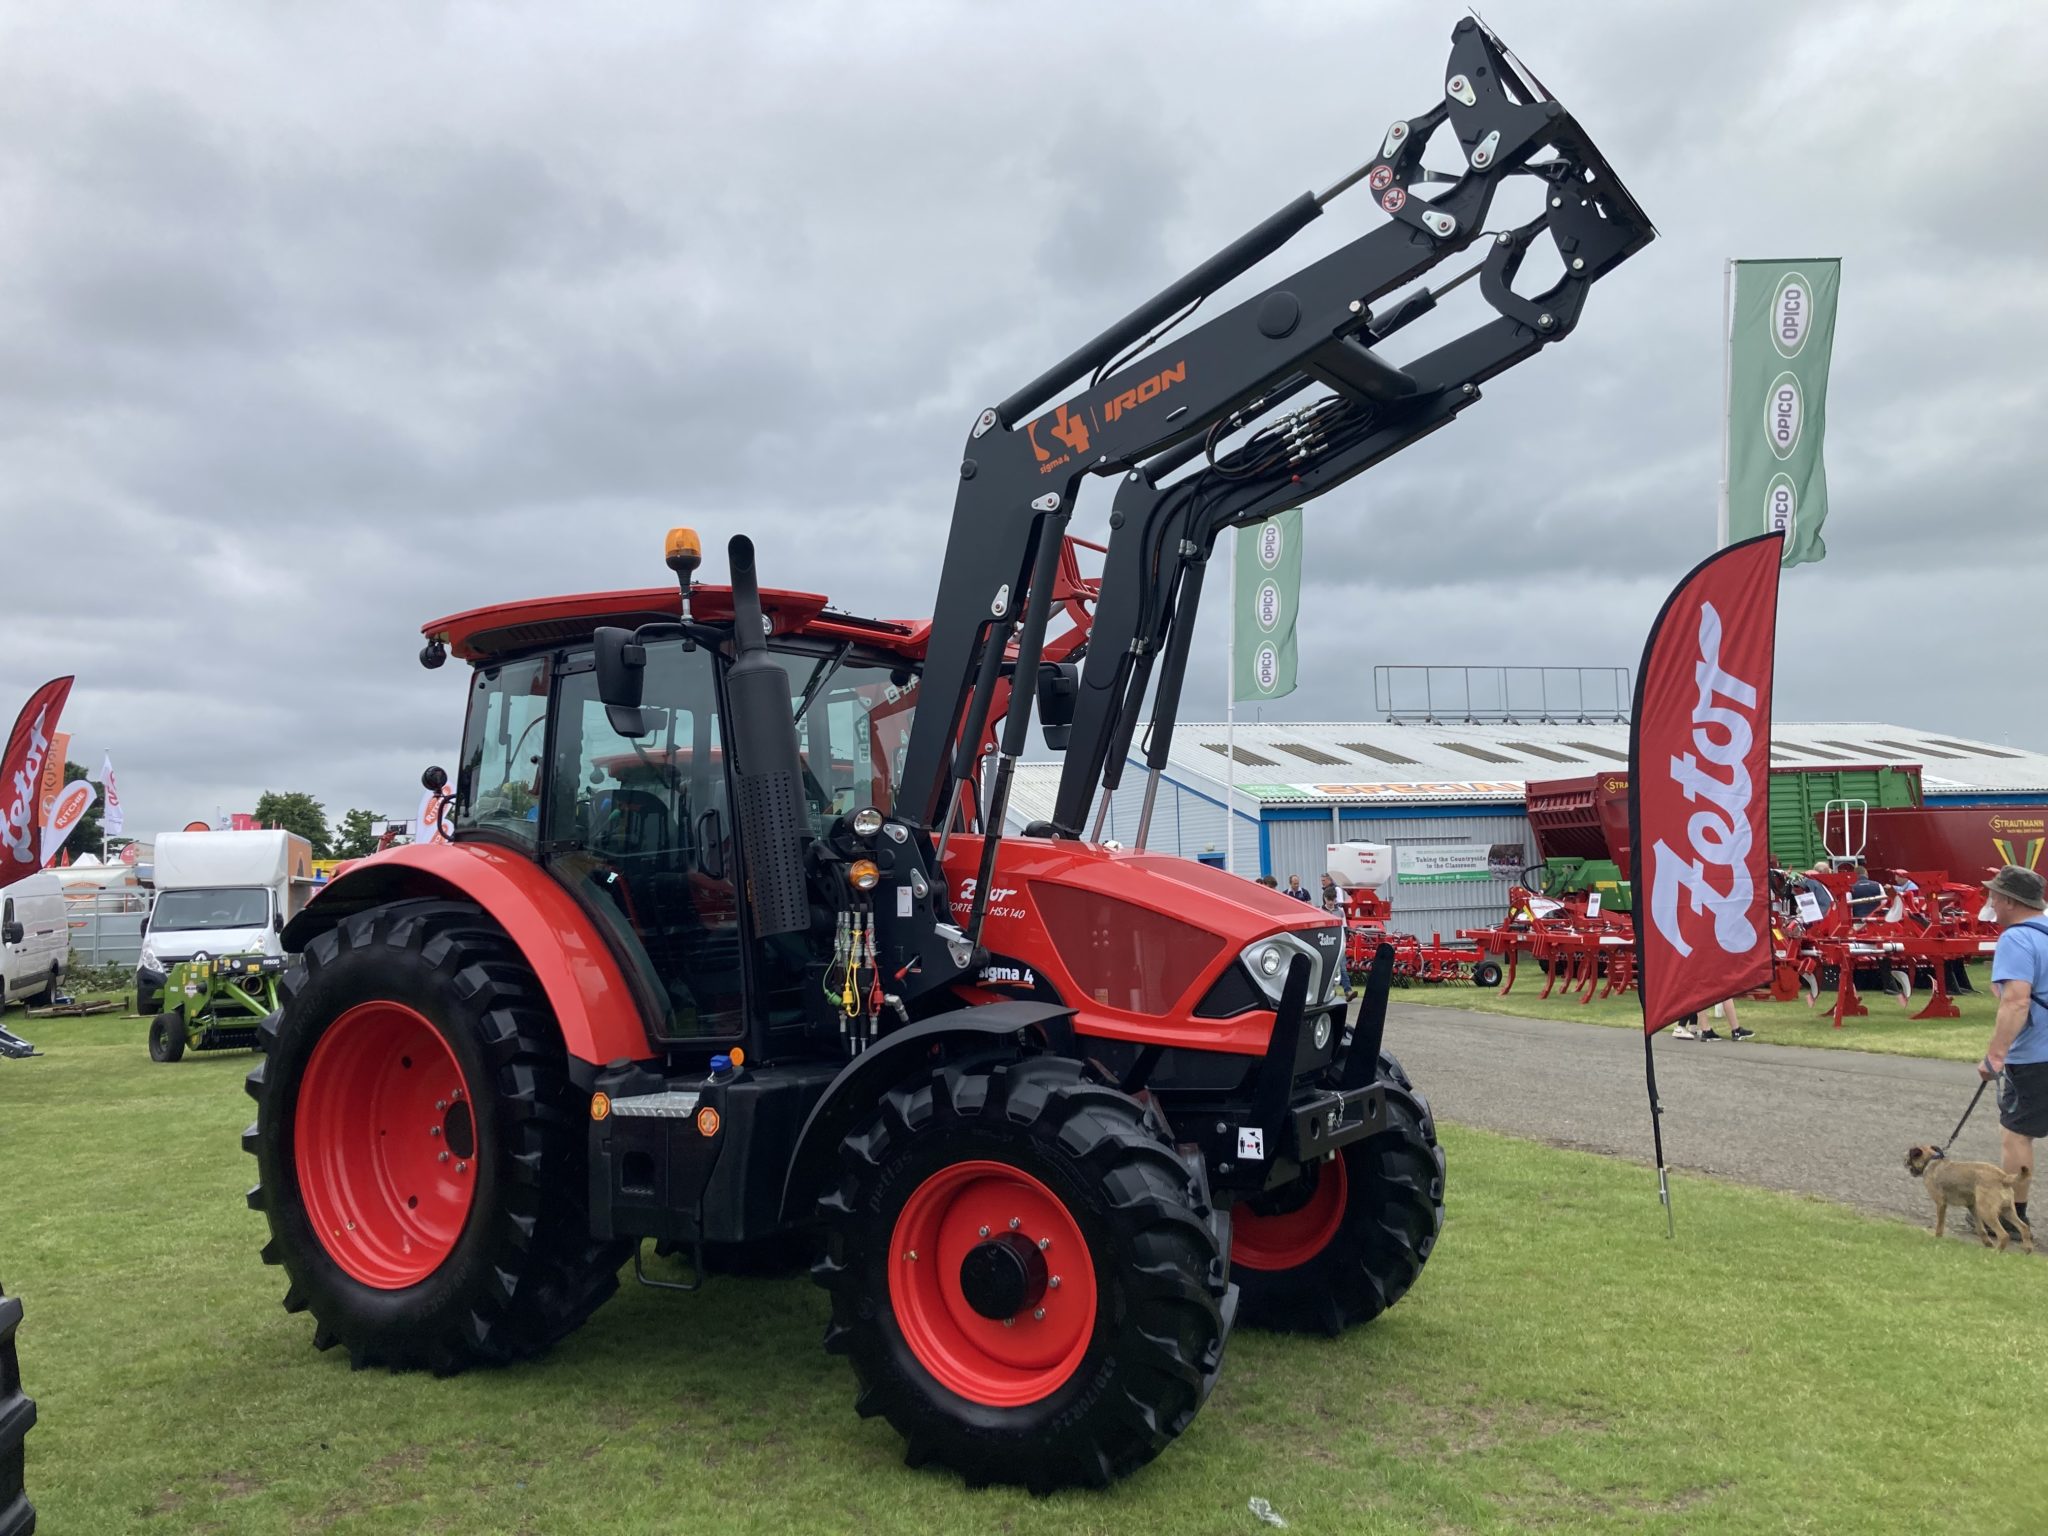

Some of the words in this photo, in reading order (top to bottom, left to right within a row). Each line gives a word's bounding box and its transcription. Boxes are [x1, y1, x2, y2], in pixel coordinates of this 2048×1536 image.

[1782, 288, 1801, 340] OPICO
[1103, 360, 1186, 422] IRON
[1777, 390, 1794, 441] OPICO
[1774, 490, 1789, 531] PICO
[1264, 527, 1276, 559] OPICO
[1263, 589, 1274, 621] OPICO
[1261, 651, 1272, 683] OPICO
[1651, 600, 1757, 958] Zetor
[56, 790, 85, 826] RITCHIE
[1994, 819, 2044, 828] STRAUTMANN
[1450, 855, 1486, 863] Countryside
[961, 878, 1017, 902] Zor
[989, 906, 1010, 917] HSX
[1010, 908, 1026, 919] 140
[1023, 968, 1034, 985] 4
